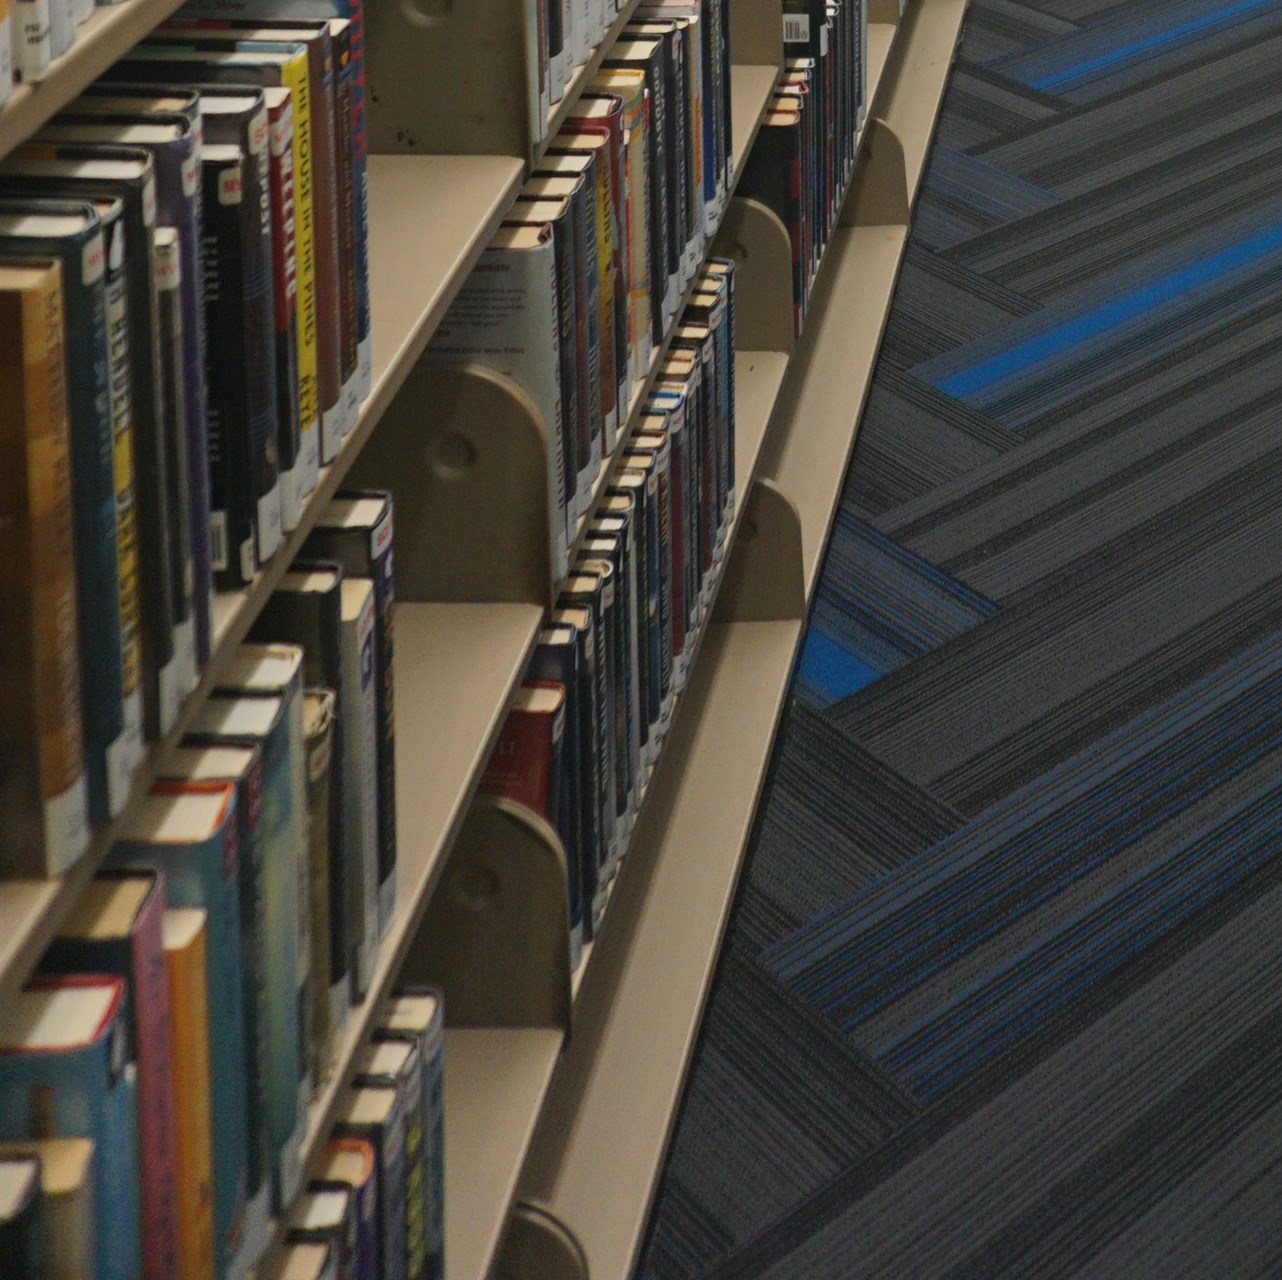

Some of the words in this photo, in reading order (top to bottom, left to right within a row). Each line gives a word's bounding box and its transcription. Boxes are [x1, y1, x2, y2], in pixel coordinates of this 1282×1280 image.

[297, 75, 308, 117] THE
[298, 121, 310, 201] HOUSE
[301, 207, 311, 232] IN
[302, 239, 313, 276] THE
[303, 287, 315, 347] PINES
[299, 374, 317, 432] REYE
